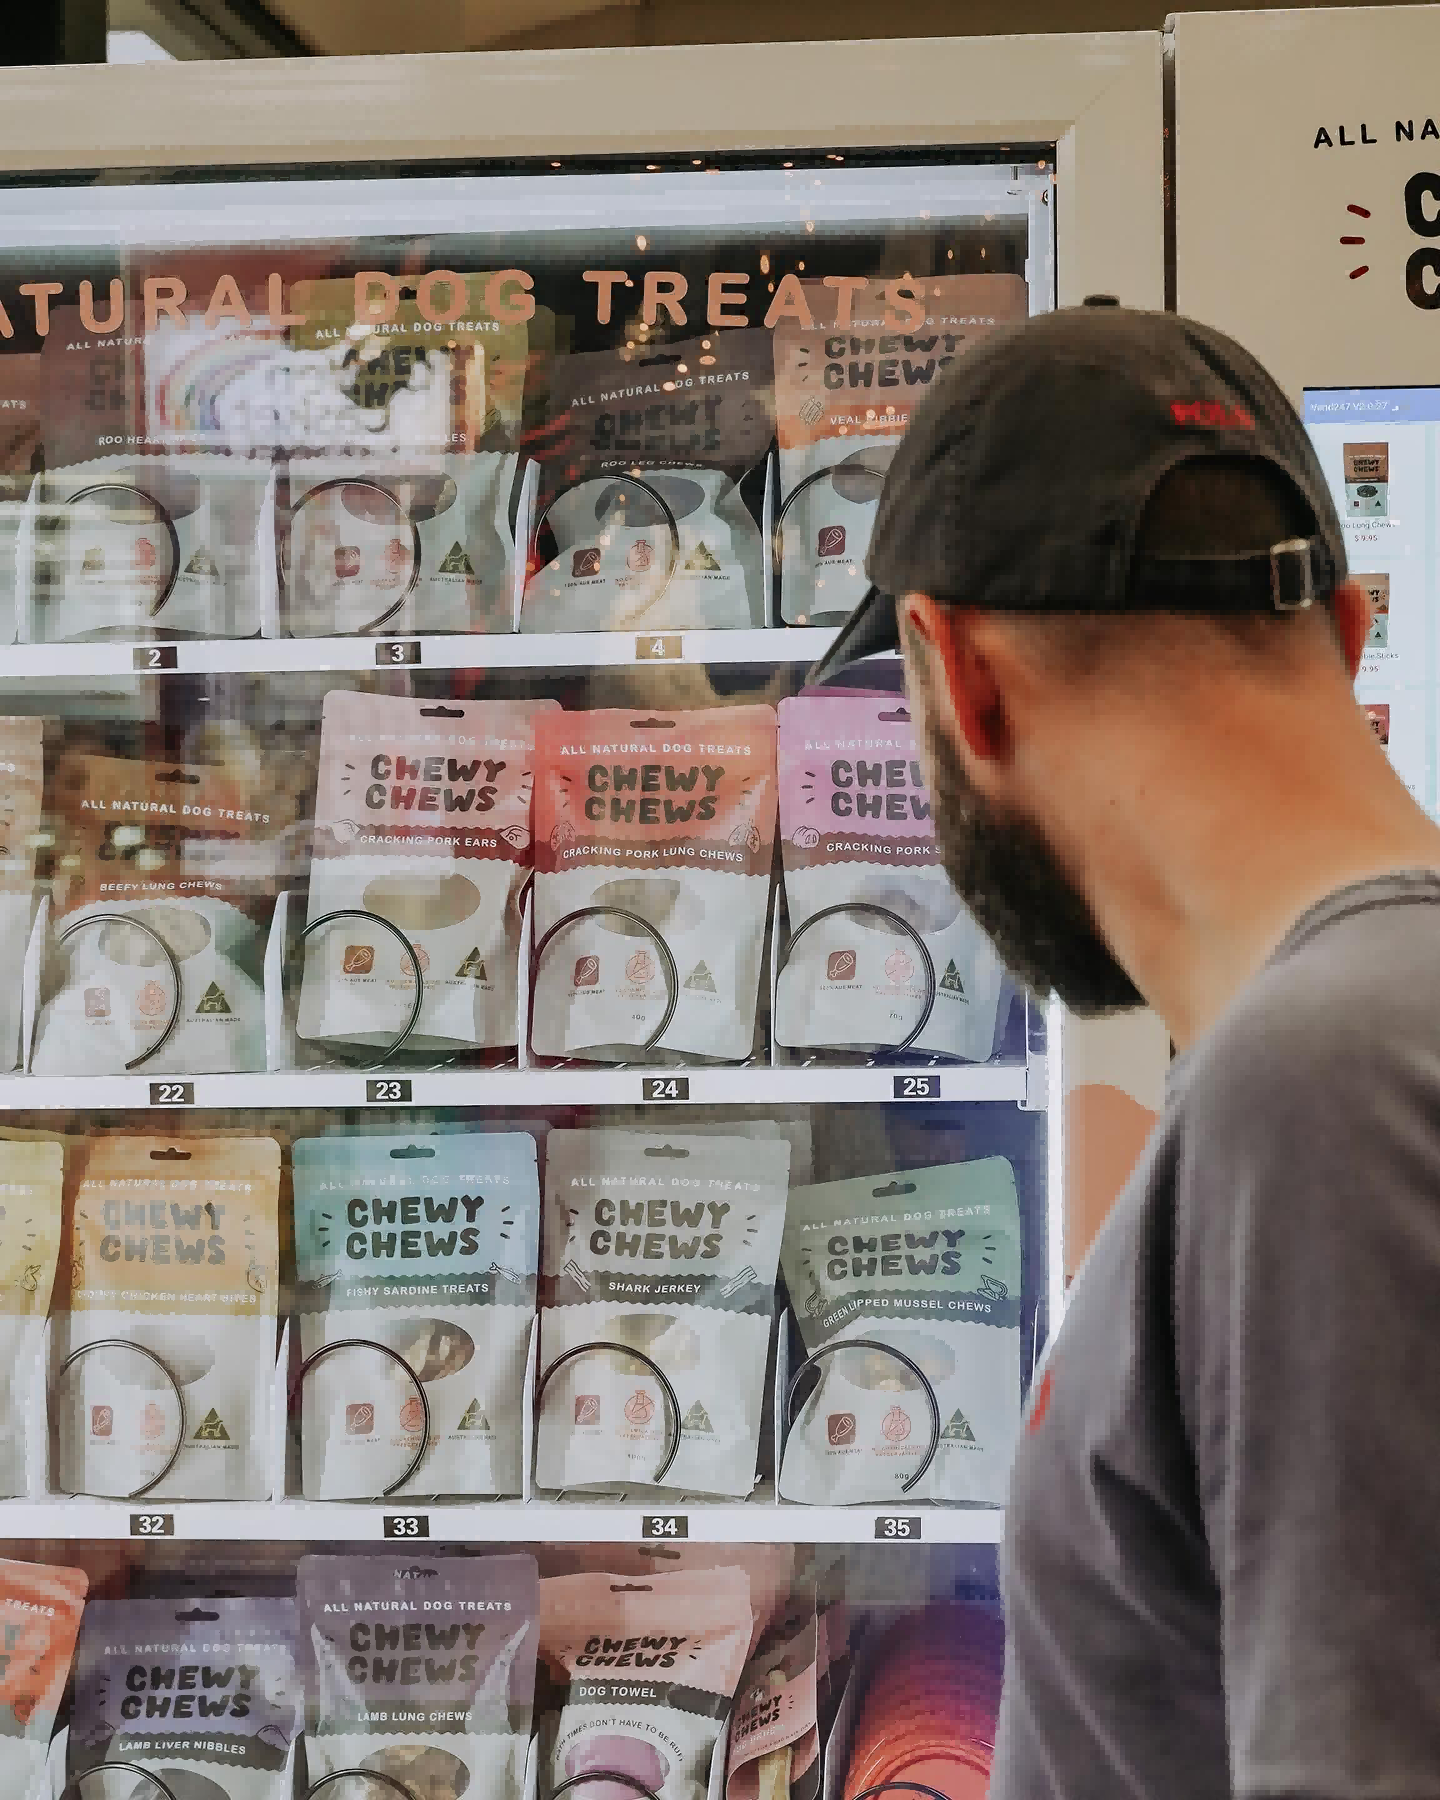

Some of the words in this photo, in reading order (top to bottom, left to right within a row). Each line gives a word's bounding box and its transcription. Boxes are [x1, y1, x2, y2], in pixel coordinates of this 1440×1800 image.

[1313, 123, 1378, 149] ALL
[354, 269, 536, 326] DOG
[582, 270, 927, 335] TREATS
[316, 328, 341, 339] ALL
[413, 322, 442, 333] DOG
[449, 322, 500, 332] TREATS
[66, 342, 91, 351] ALL
[97, 337, 149, 347] NATUR
[571, 394, 596, 408] ALL
[600, 383, 661, 402] NATURAL
[663, 378, 694, 392] OG
[699, 371, 751, 386] TREATS
[830, 415, 862, 426] VEAL
[98, 434, 123, 446] ROO
[444, 433, 467, 443] LES
[601, 459, 627, 468] ROO
[391, 643, 405, 662] 3
[649, 637, 666, 657] 4
[148, 648, 162, 667] 2
[1361, 665, 1379, 673] 9.95
[560, 745, 586, 756] ALL
[592, 743, 657, 754] NATURAL
[662, 743, 692, 753] DOG
[698, 743, 752, 756] TREATS
[370, 753, 507, 783] CHEWY
[587, 763, 726, 793] CHEWY
[365, 783, 498, 812] CHEWS
[831, 791, 931, 821] CHEW
[81, 799, 107, 810] ALL
[112, 800, 177, 815] NATURAL
[182, 804, 212, 818] DOG
[218, 808, 271, 824] TREATS
[584, 795, 718, 825] CHEWS
[360, 834, 424, 846] CRACKING
[427, 835, 461, 847] PORK
[464, 837, 498, 848] EARS
[826, 842, 892, 855] CRACKING
[896, 845, 931, 856] PORK
[563, 845, 622, 860] CRACKING
[625, 849, 660, 860] PORK
[663, 846, 695, 858] LUNG
[699, 848, 744, 863] CHEWS
[100, 883, 139, 892] BEEFY
[142, 881, 176, 890] LUNG
[179, 880, 223, 891] CHEWS
[158, 1084, 185, 1102] 22
[375, 1081, 402, 1101] 23
[652, 1080, 679, 1098] 24
[903, 1077, 930, 1096] 25
[571, 1177, 596, 1187] ALL
[601, 1176, 665, 1187] NATURAL
[102, 1200, 226, 1231] CHEWY
[346, 1194, 485, 1228] CHEWY
[593, 1198, 731, 1229] CHEWY
[802, 1223, 828, 1232] ALL
[833, 1213, 898, 1228] NATURAL
[100, 1234, 226, 1265] CHEWS
[345, 1227, 481, 1260] CHEWS
[589, 1229, 724, 1260] CHEWS
[827, 1229, 966, 1257] CHEWY
[826, 1250, 962, 1281] CHEWS
[346, 1285, 379, 1297] FISHY
[383, 1284, 438, 1296] SARDINE
[442, 1282, 489, 1294] TREATS
[608, 1281, 651, 1294] SHARK
[654, 1283, 702, 1294] JERKEY
[823, 1307, 850, 1329] GREEN
[848, 1298, 889, 1313] LIPPED
[893, 1298, 944, 1310] MUSSEL
[948, 1300, 992, 1314] CHEWS
[139, 1515, 165, 1534] 32
[393, 1517, 419, 1536] 33
[651, 1517, 678, 1536] 34
[884, 1518, 910, 1537] 35
[324, 1603, 349, 1613] ALL
[354, 1600, 418, 1612] NATURAL
[423, 1601, 453, 1611] DOG
[459, 1601, 512, 1611] TREATS
[349, 1621, 486, 1652] CHEWY
[583, 1635, 688, 1655] CHEWY
[135, 1643, 197, 1654] NATURAL
[574, 1650, 678, 1669] CHEWS
[125, 1663, 260, 1692] CHEWY
[348, 1654, 480, 1686] CHEWS
[579, 1685, 607, 1698] DOG
[610, 1686, 658, 1699] TOWEL
[120, 1692, 252, 1720] CHEWS
[357, 1711, 389, 1722] LAMB
[392, 1711, 426, 1722] LUNG
[429, 1710, 473, 1722] CHEWS
[589, 1718, 617, 1728] DON'T
[618, 1719, 644, 1730] HAVE
[645, 1723, 658, 1734] TO
[657, 1731, 670, 1743] BE
[118, 1741, 152, 1752] LAMB
[155, 1740, 190, 1751] LIVER
[193, 1740, 247, 1755] NIBBLES
